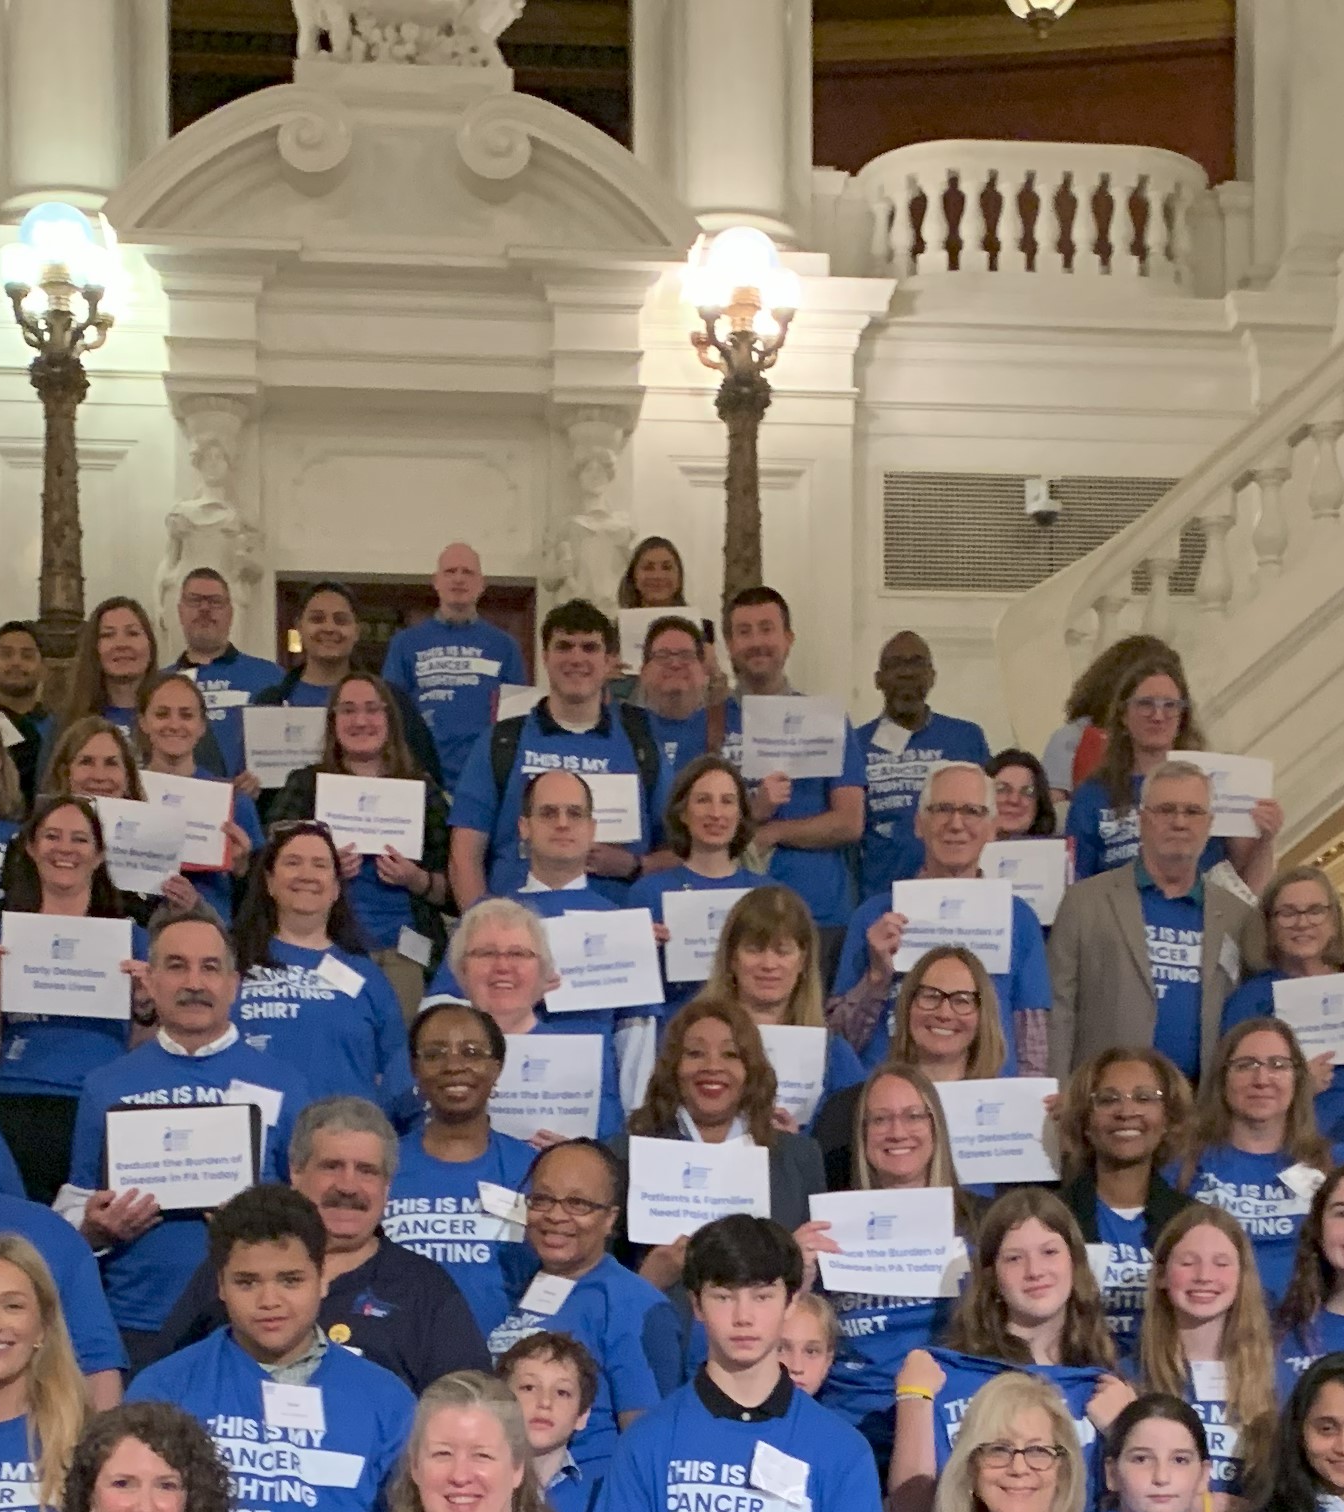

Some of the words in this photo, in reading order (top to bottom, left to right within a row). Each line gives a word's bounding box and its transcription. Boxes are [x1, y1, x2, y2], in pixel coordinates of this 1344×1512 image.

[524, 749, 562, 768] THIS
[562, 755, 580, 769] IS
[581, 757, 611, 771] MY
[240, 983, 336, 1001] FIGHTING
[240, 1001, 301, 1020] SHIRT
[120, 1088, 170, 1105] THIS
[172, 1085, 193, 1104] IS
[1240, 1183, 1261, 1198] IS
[383, 1197, 431, 1217] THIS
[435, 1196, 457, 1214] IS
[218, 1447, 303, 1474] ANCER
[720, 1463, 747, 1486] IS
